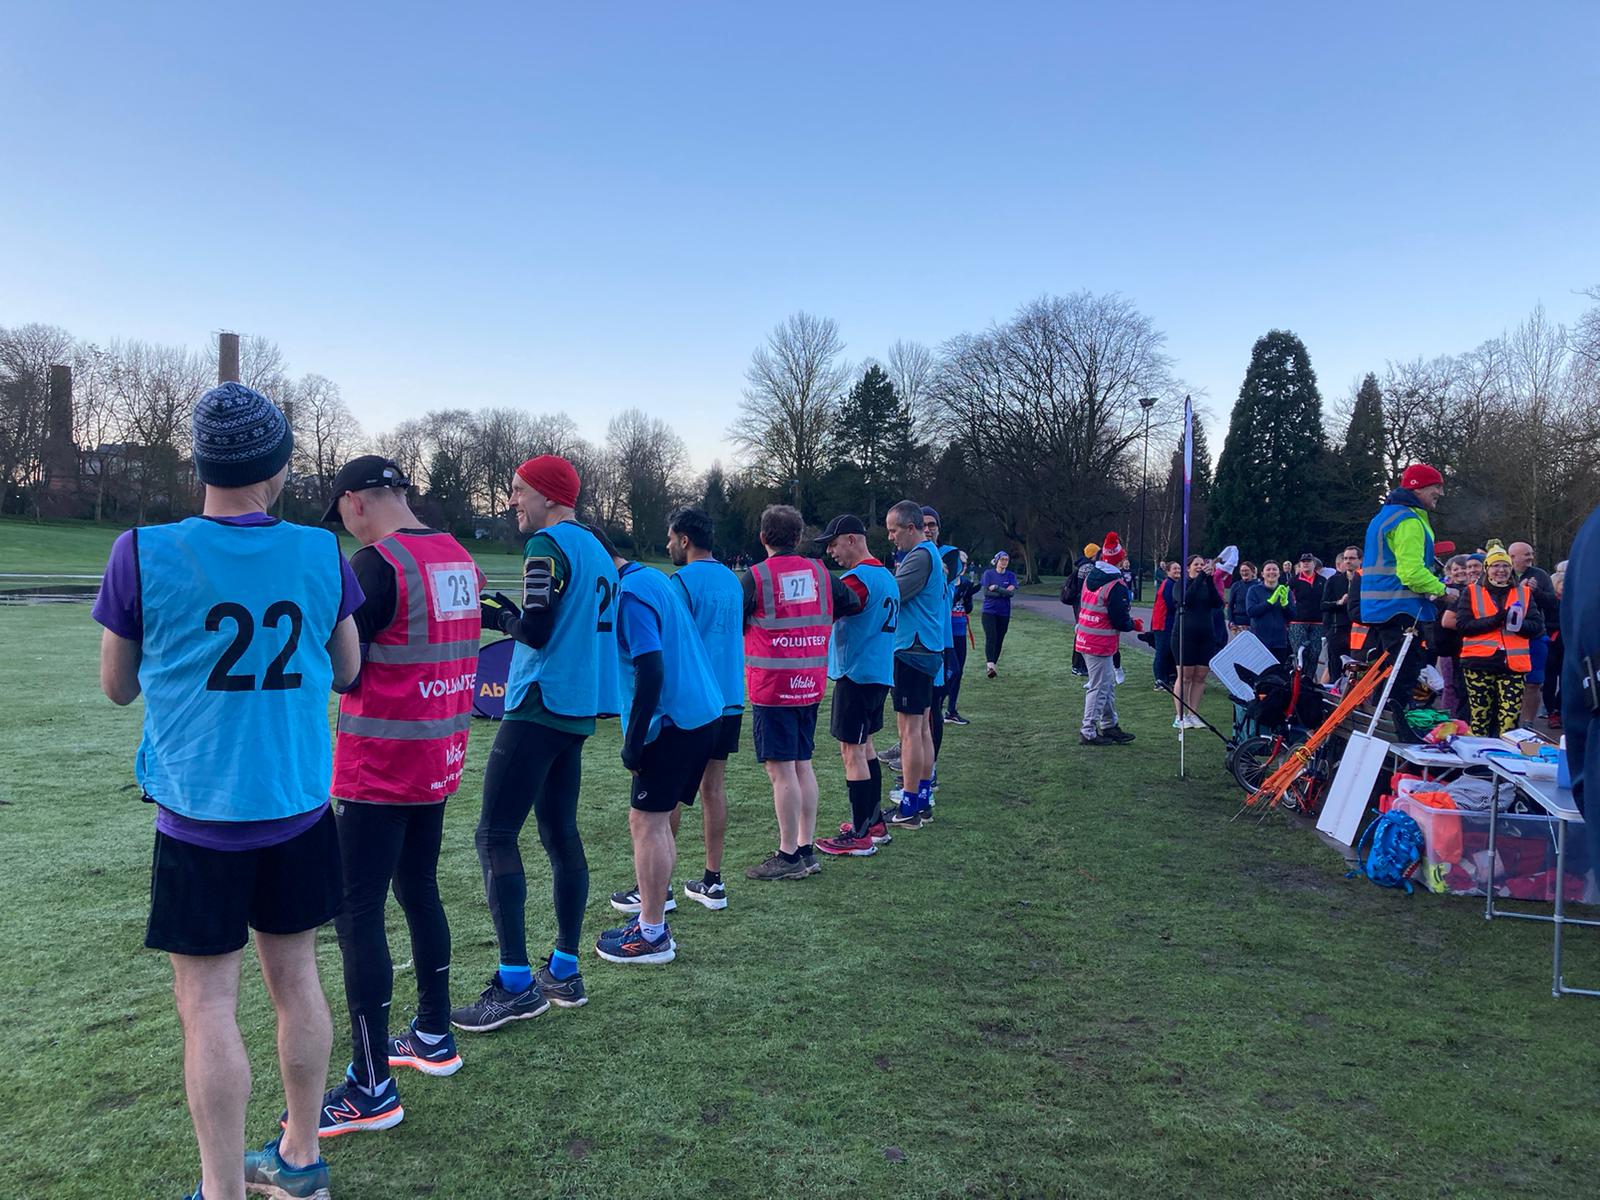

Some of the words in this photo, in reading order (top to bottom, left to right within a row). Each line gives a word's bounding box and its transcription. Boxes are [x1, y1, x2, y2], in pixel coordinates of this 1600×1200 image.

[448, 575, 470, 606] 23
[790, 578, 806, 598] 27
[204, 600, 303, 691] 22
